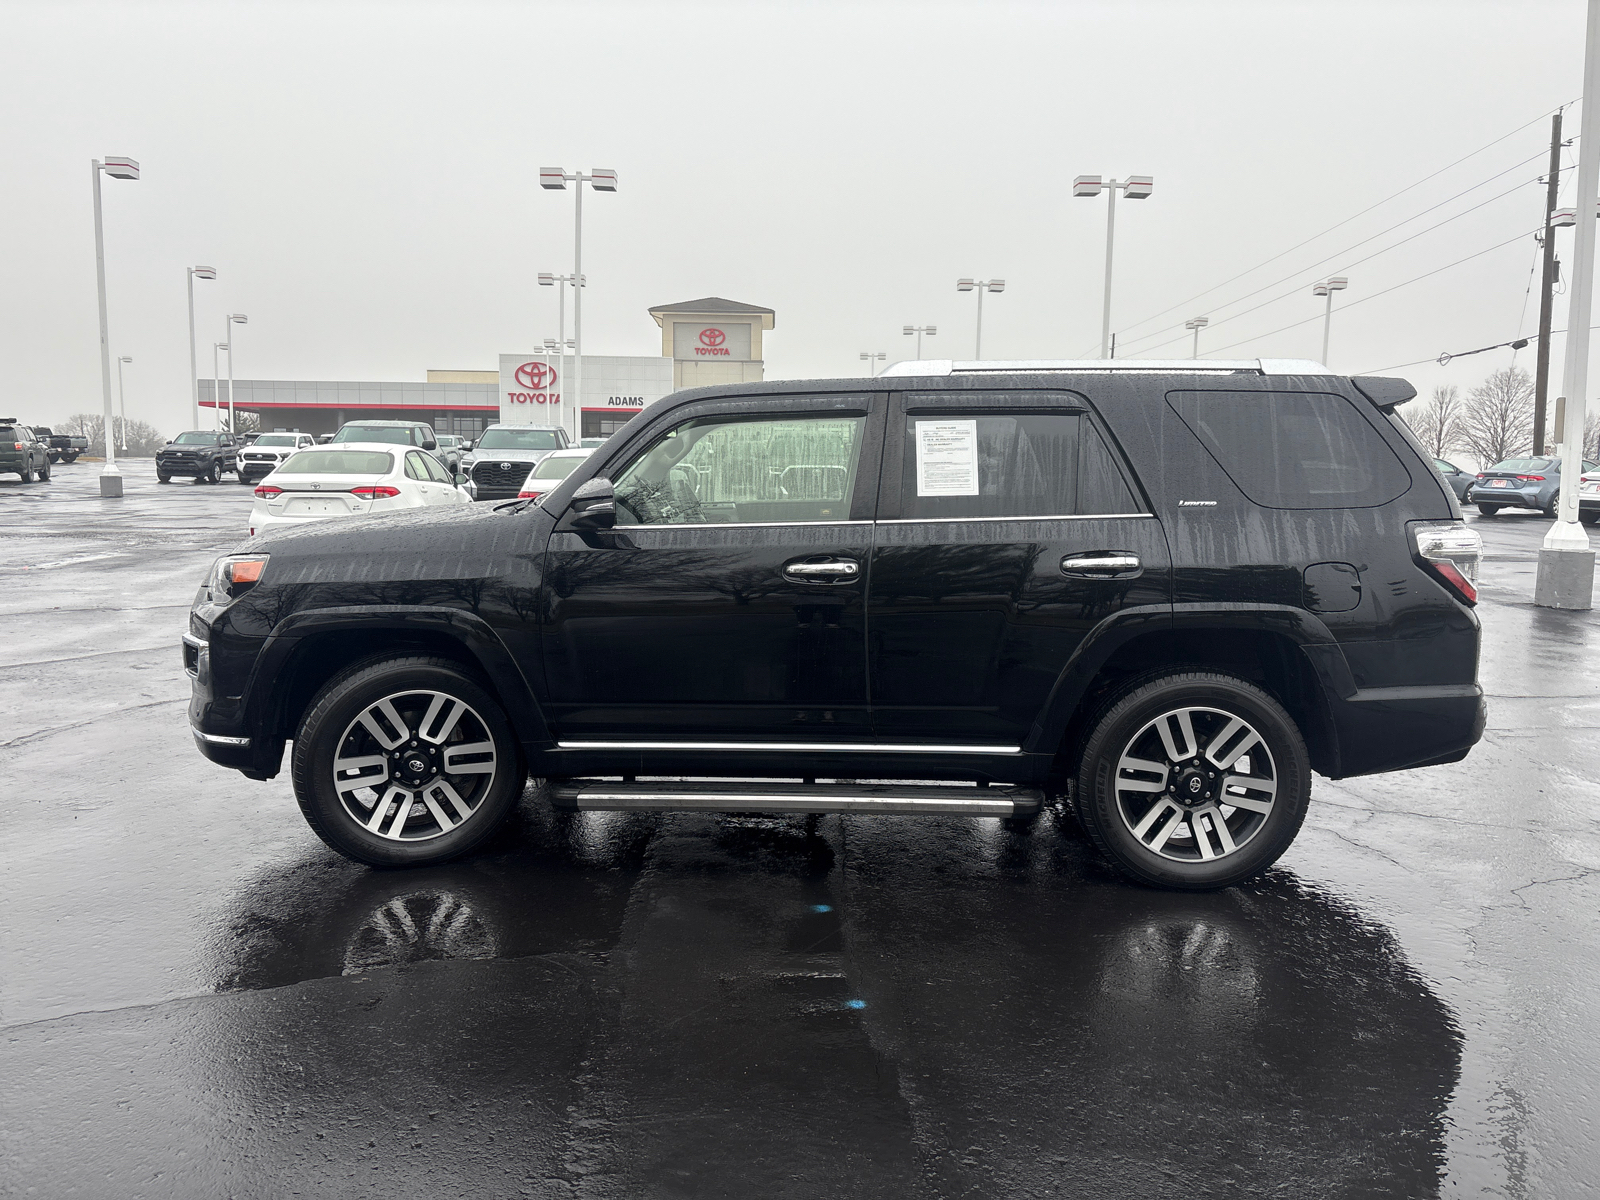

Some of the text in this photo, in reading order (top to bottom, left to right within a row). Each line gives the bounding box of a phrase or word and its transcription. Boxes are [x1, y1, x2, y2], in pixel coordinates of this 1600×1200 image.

[694, 347, 731, 356] TOYOTA
[607, 396, 644, 407] ADAMS
[1097, 761, 1114, 829] MICHELIN
